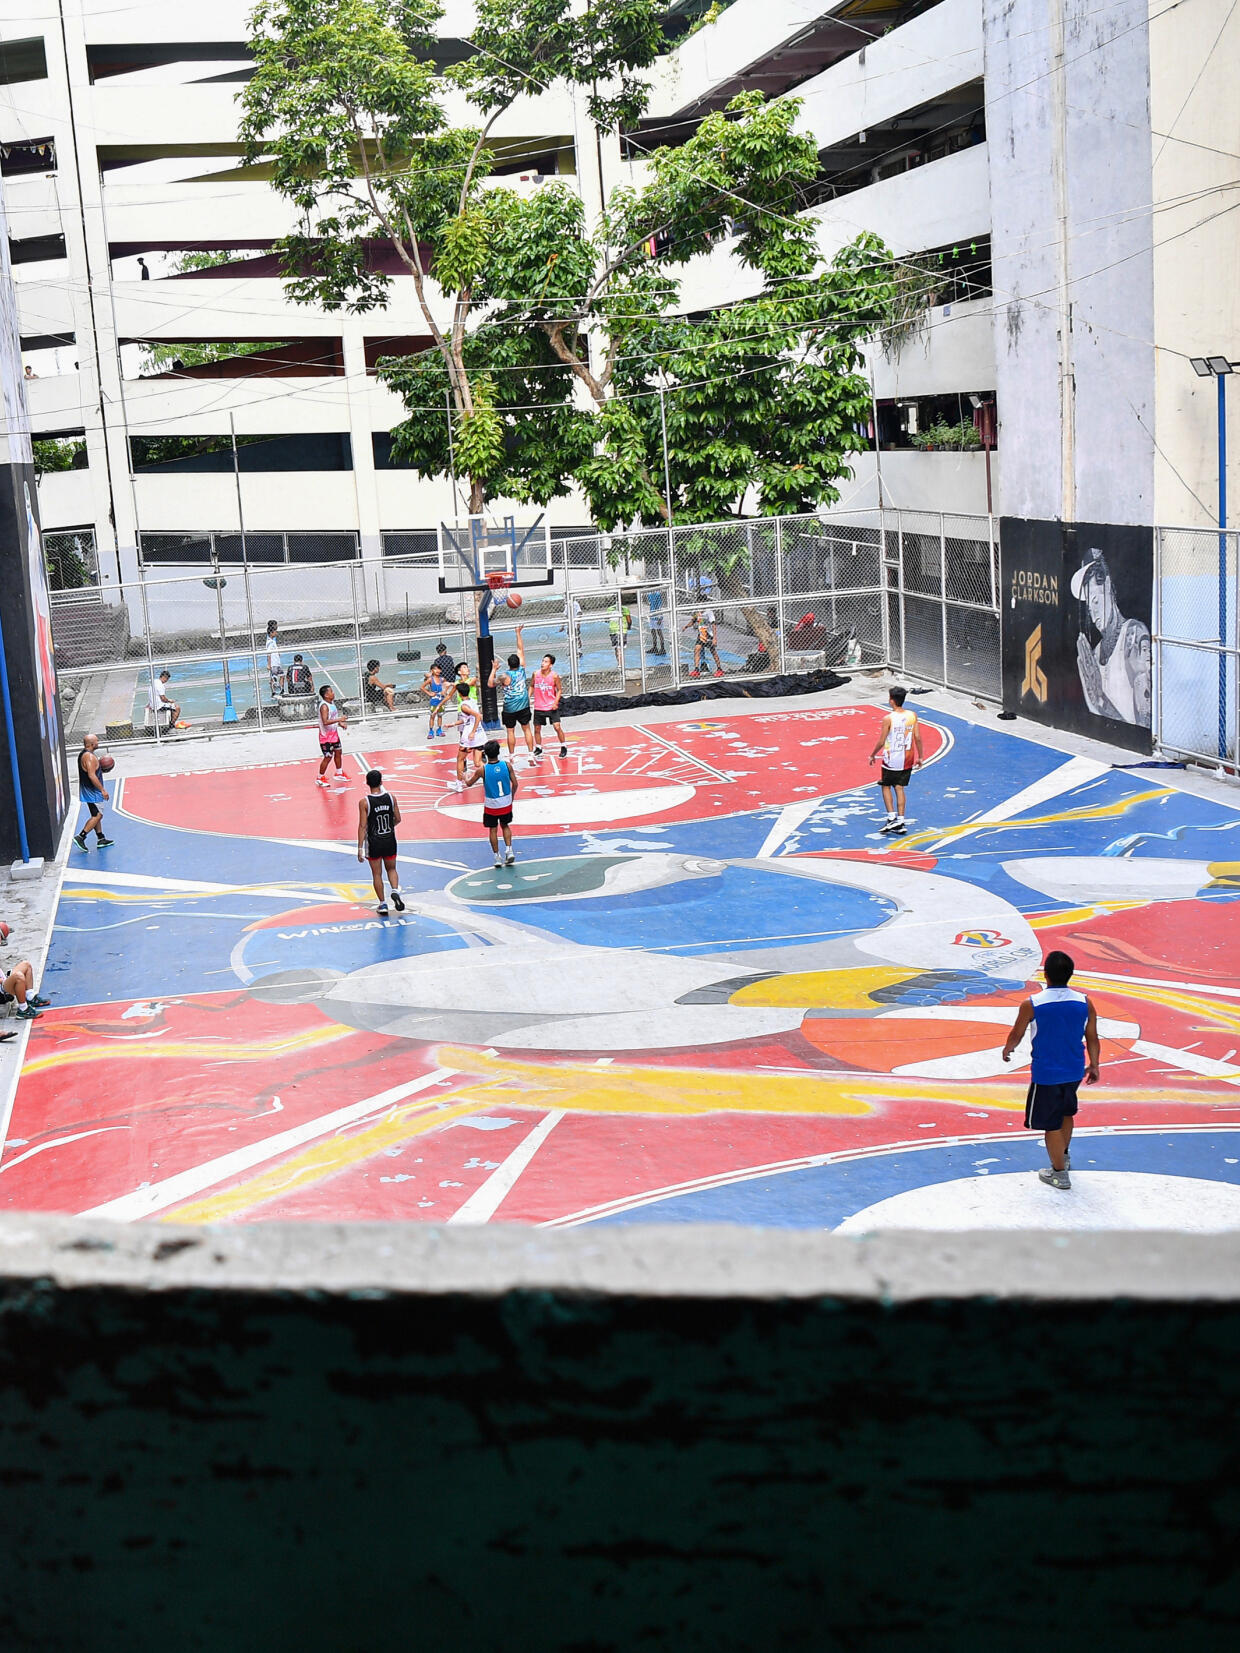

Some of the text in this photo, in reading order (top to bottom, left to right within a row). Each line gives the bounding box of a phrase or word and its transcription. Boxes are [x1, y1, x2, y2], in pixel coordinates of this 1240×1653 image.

[1012, 570, 1058, 590] JORDAN
[1012, 586, 1058, 606] CLARKSON
[497, 780, 505, 797] 1
[376, 813, 392, 835] 11
[277, 926, 340, 940] WIN
[364, 919, 417, 931] ALL
